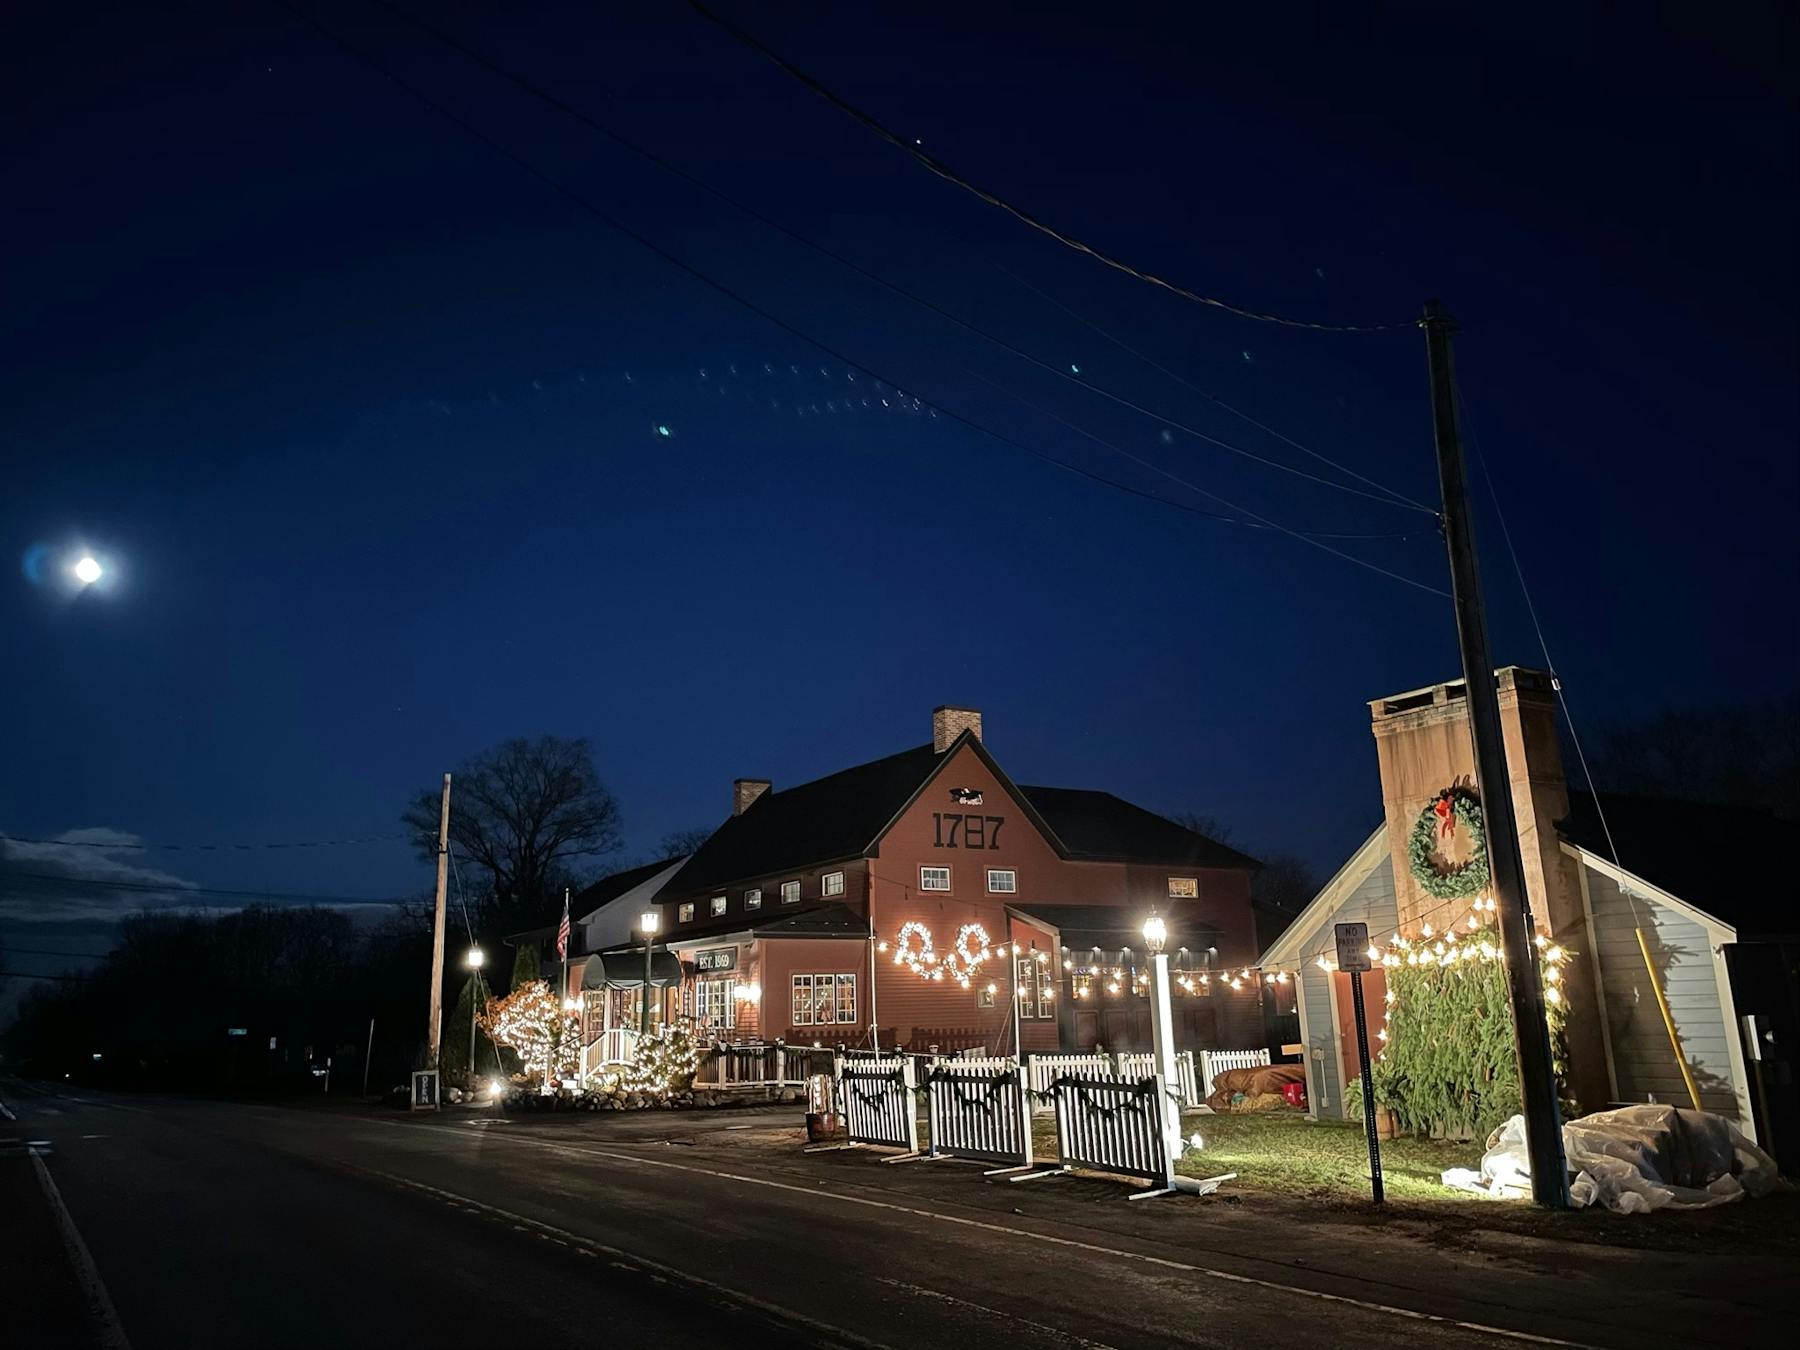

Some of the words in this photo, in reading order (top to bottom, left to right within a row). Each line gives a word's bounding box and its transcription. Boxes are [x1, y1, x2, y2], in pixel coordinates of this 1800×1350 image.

[933, 813, 1004, 850] 1787
[1345, 926, 1358, 937] NO
[699, 956, 714, 969] EST.
